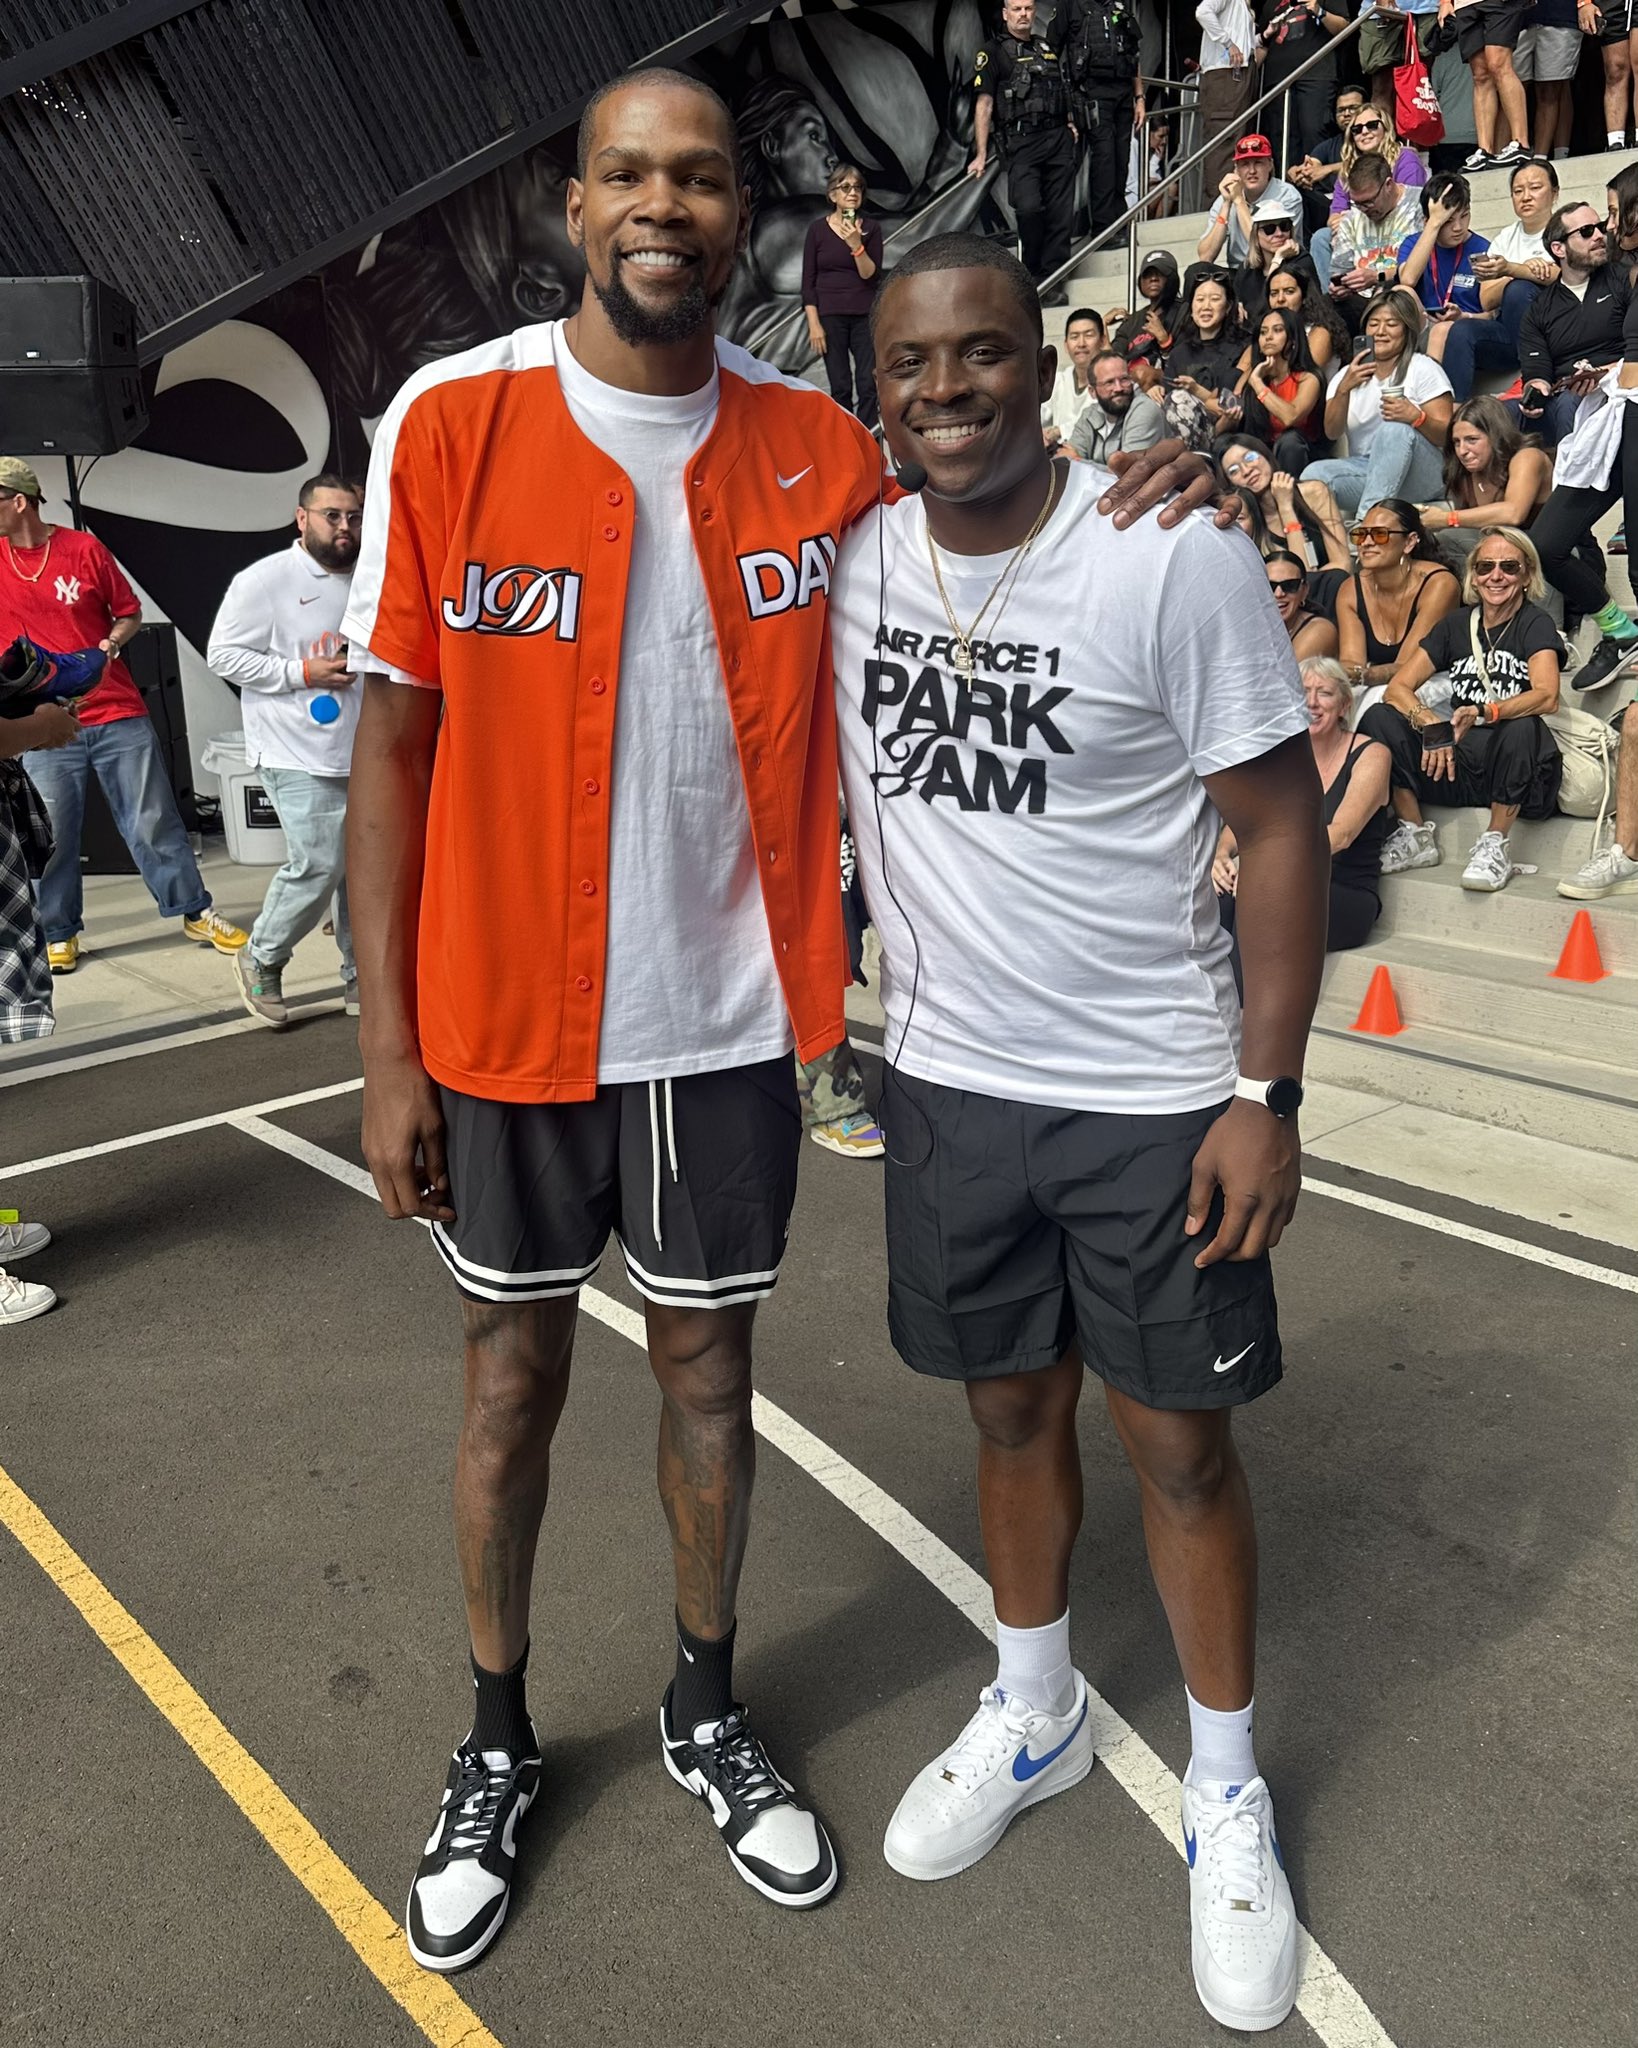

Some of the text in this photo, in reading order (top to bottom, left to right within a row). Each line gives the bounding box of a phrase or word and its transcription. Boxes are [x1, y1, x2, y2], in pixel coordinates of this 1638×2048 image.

[53, 575, 81, 605] NY
[873, 624, 1061, 677] AIR FORCE 1
[861, 659, 1075, 754] PARK
[869, 728, 1048, 815] JAM
